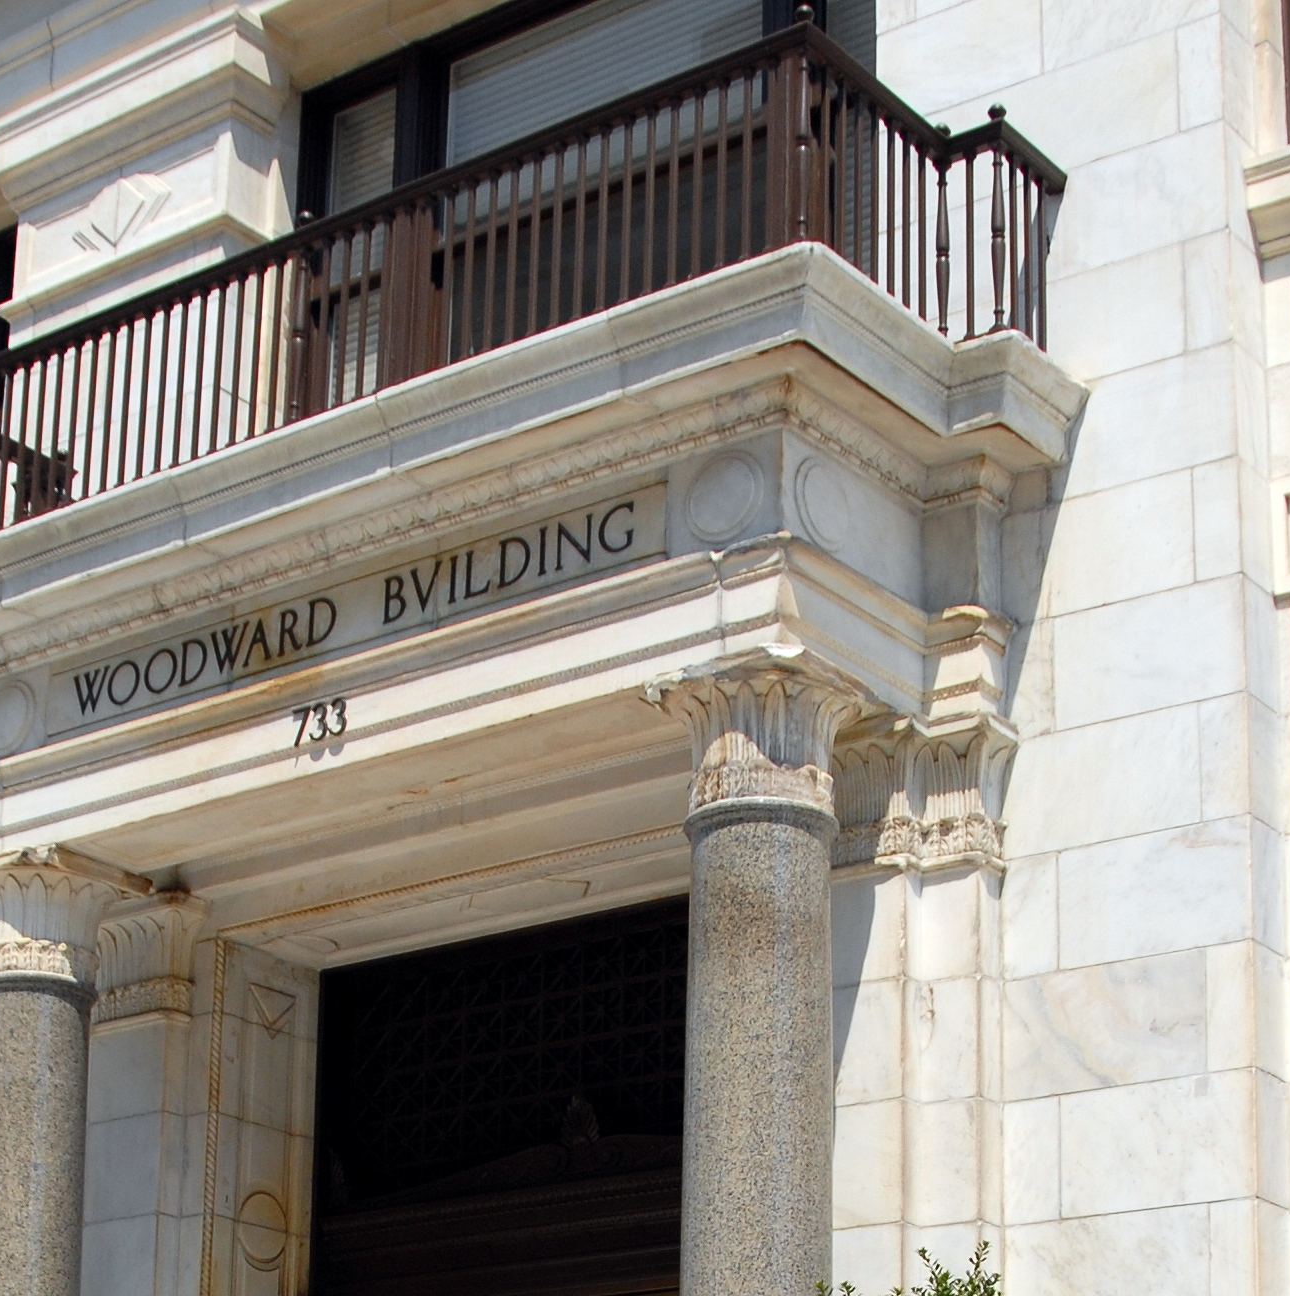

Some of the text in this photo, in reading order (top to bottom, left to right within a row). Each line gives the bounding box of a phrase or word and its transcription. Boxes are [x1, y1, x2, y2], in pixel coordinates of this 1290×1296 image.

[73, 501, 634, 716] WOODWARD BVILDING
[292, 697, 348, 747] 733
